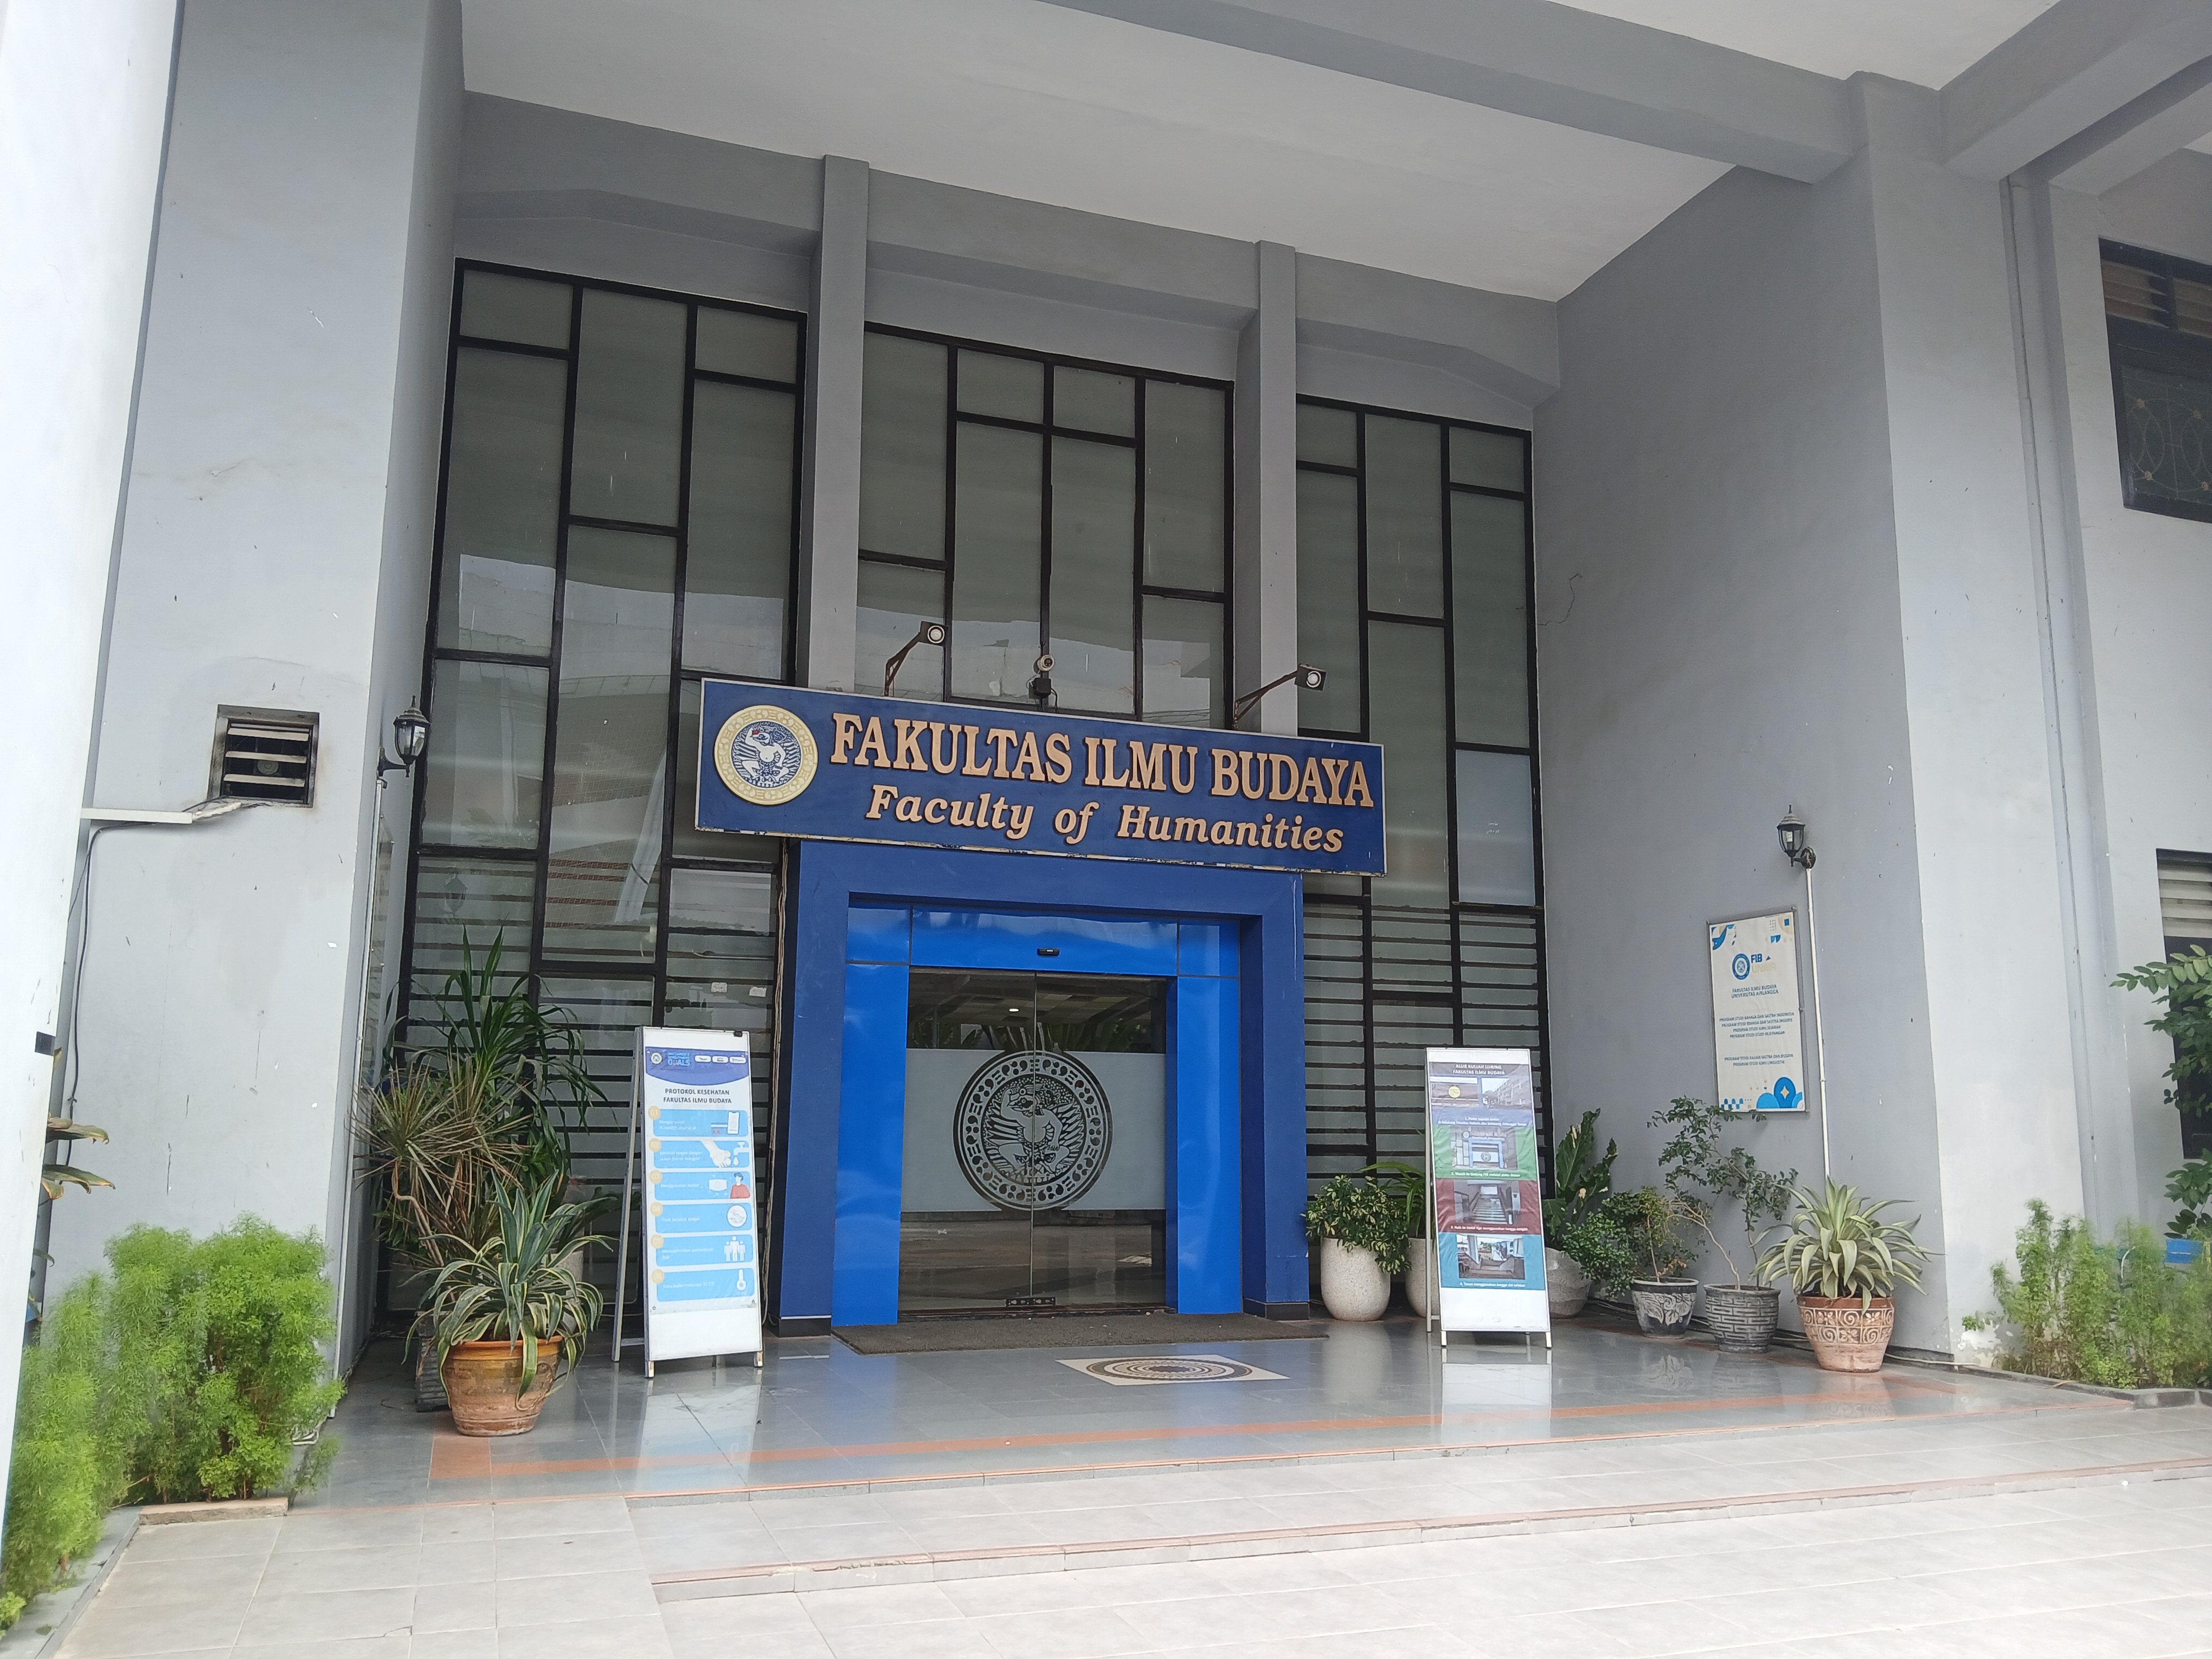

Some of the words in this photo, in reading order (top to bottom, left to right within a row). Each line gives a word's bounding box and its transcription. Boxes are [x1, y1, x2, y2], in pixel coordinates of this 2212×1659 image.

[831, 712, 1072, 784] FAKULTAS
[1084, 737, 1198, 794] ILMU
[1211, 748, 1374, 807] BUDAYA
[866, 784, 1034, 839] Faculty
[1054, 801, 1099, 845] of
[1117, 805, 1343, 852] Humanities
[1751, 953, 1763, 963] FIB
[1752, 963, 1776, 973] UNAIR
